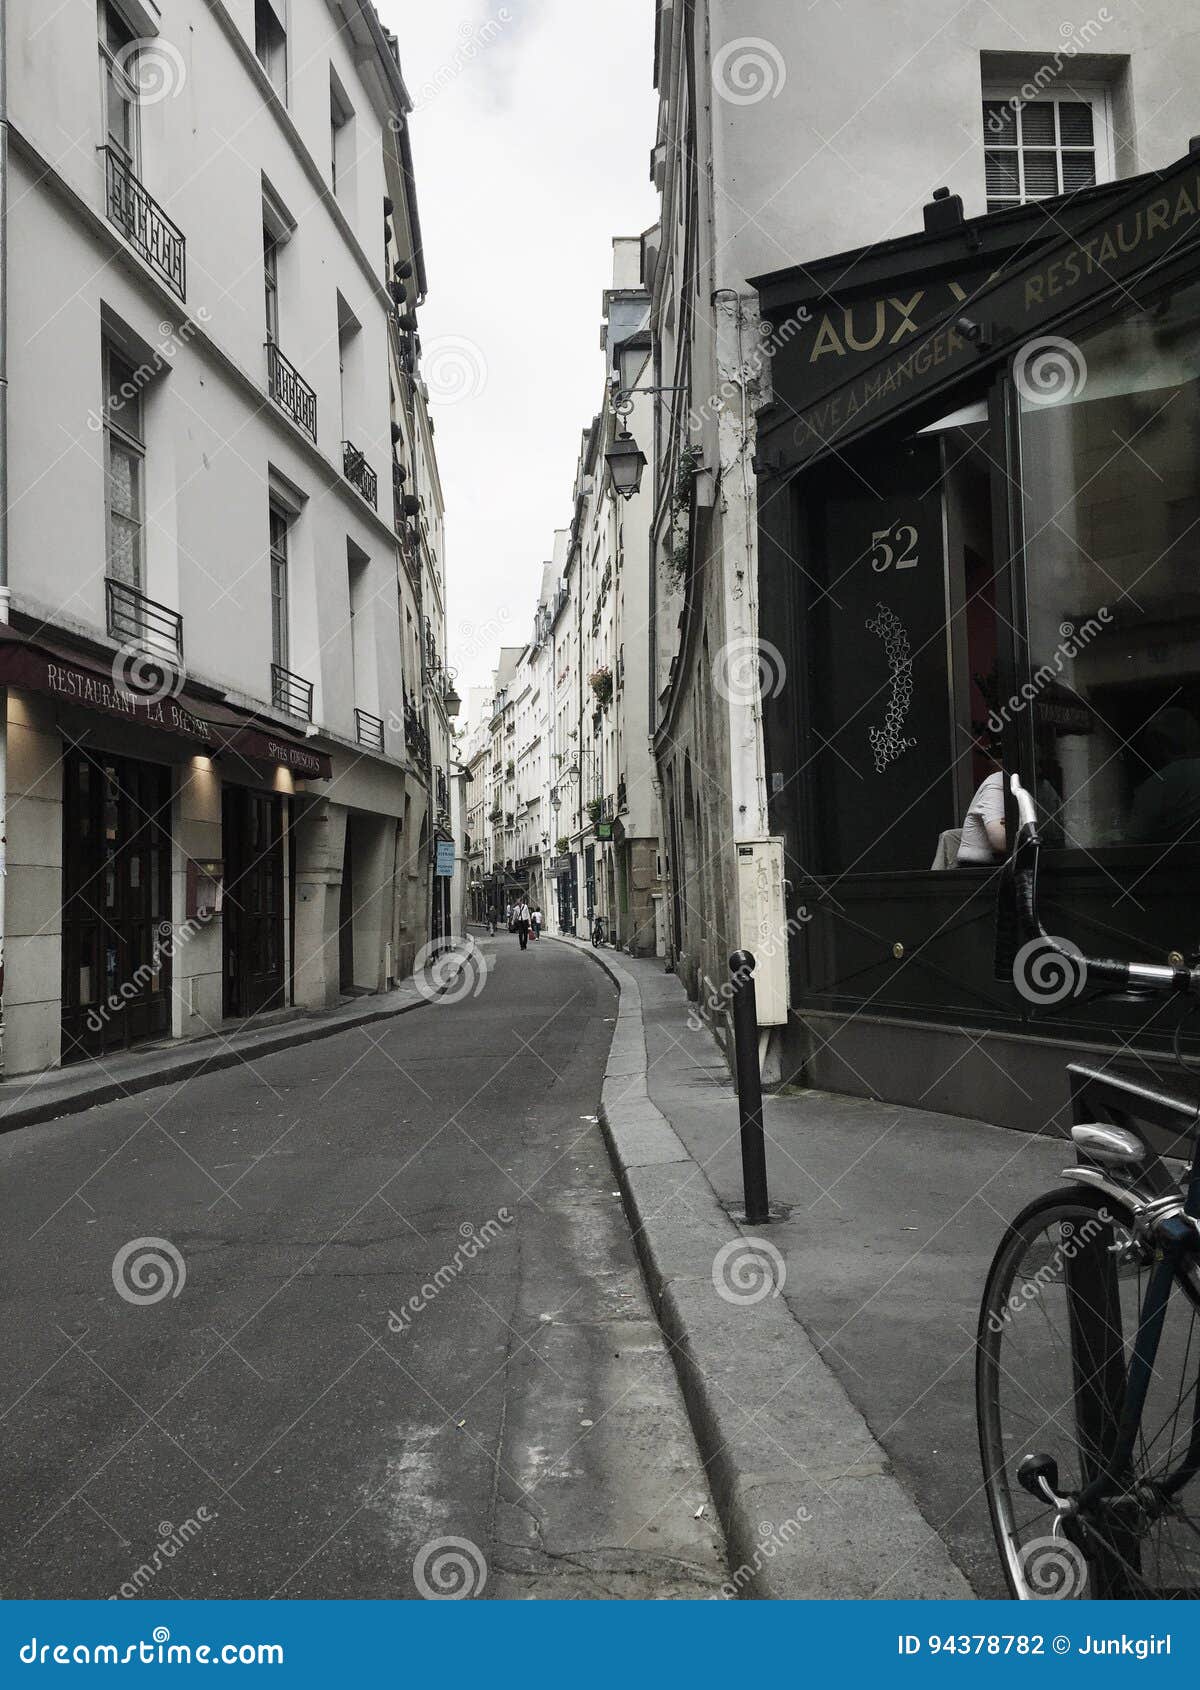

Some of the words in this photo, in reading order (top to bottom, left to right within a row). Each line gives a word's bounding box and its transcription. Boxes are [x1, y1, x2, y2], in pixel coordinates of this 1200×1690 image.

[809, 290, 925, 363] AUX
[871, 525, 919, 572] 52
[47, 664, 137, 715] RESTAURANT
[147, 699, 164, 723] LA
